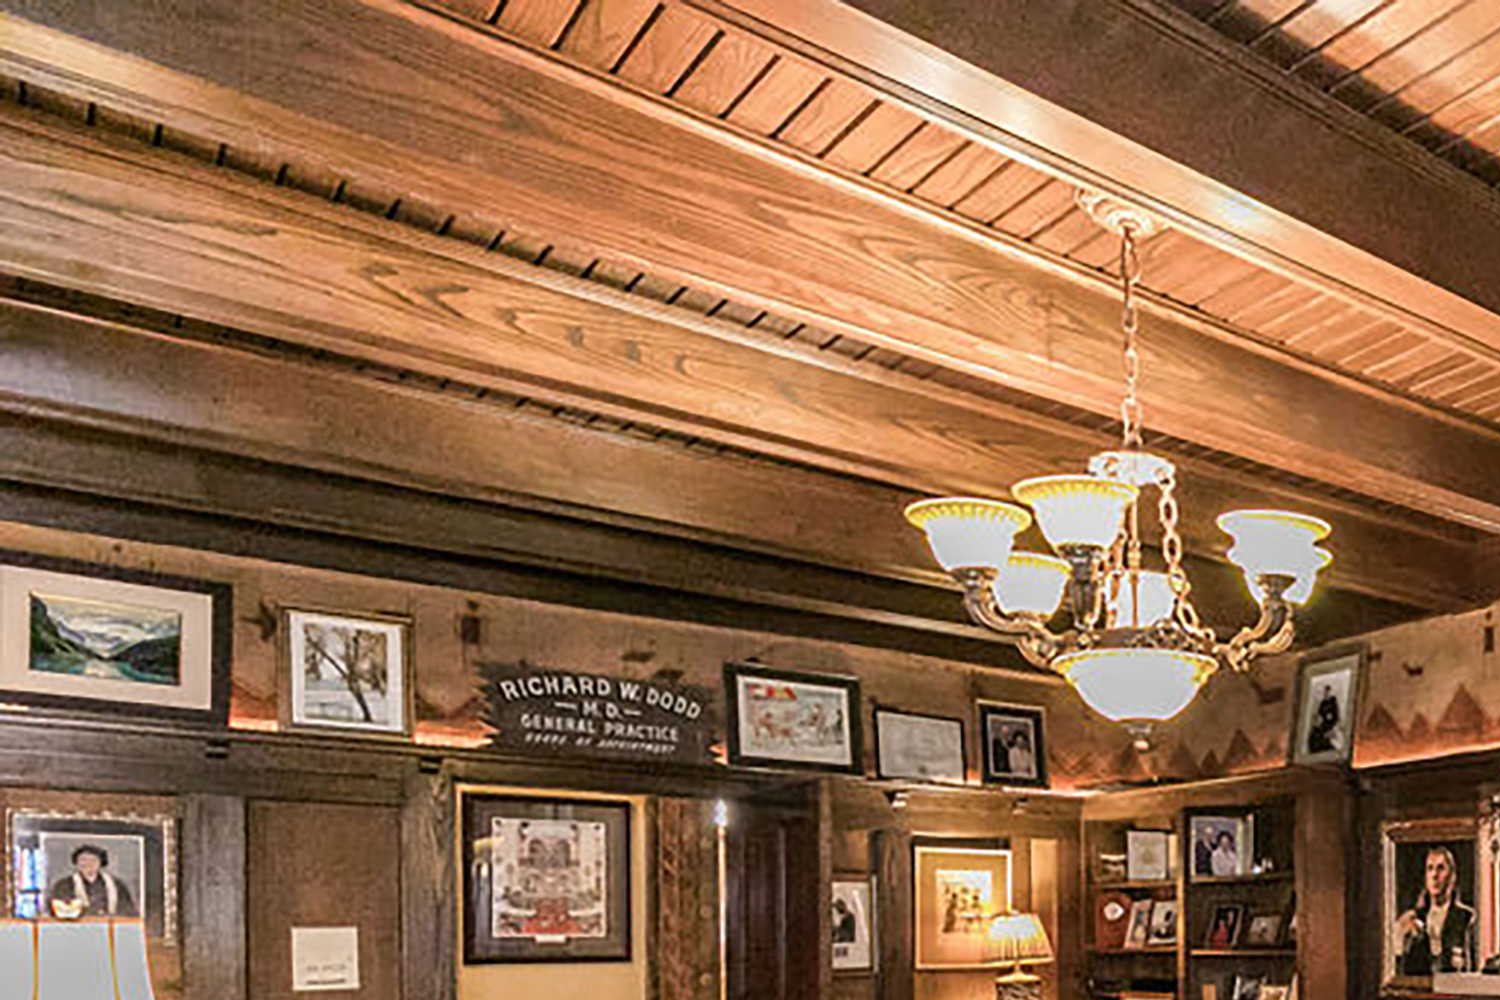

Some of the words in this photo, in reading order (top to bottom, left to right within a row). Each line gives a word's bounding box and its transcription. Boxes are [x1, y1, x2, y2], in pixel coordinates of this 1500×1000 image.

[500, 676, 611, 700] RICHARD
[646, 688, 701, 719] DODD
[521, 714, 596, 734] GENERAL
[604, 722, 679, 742] PRACTICE
